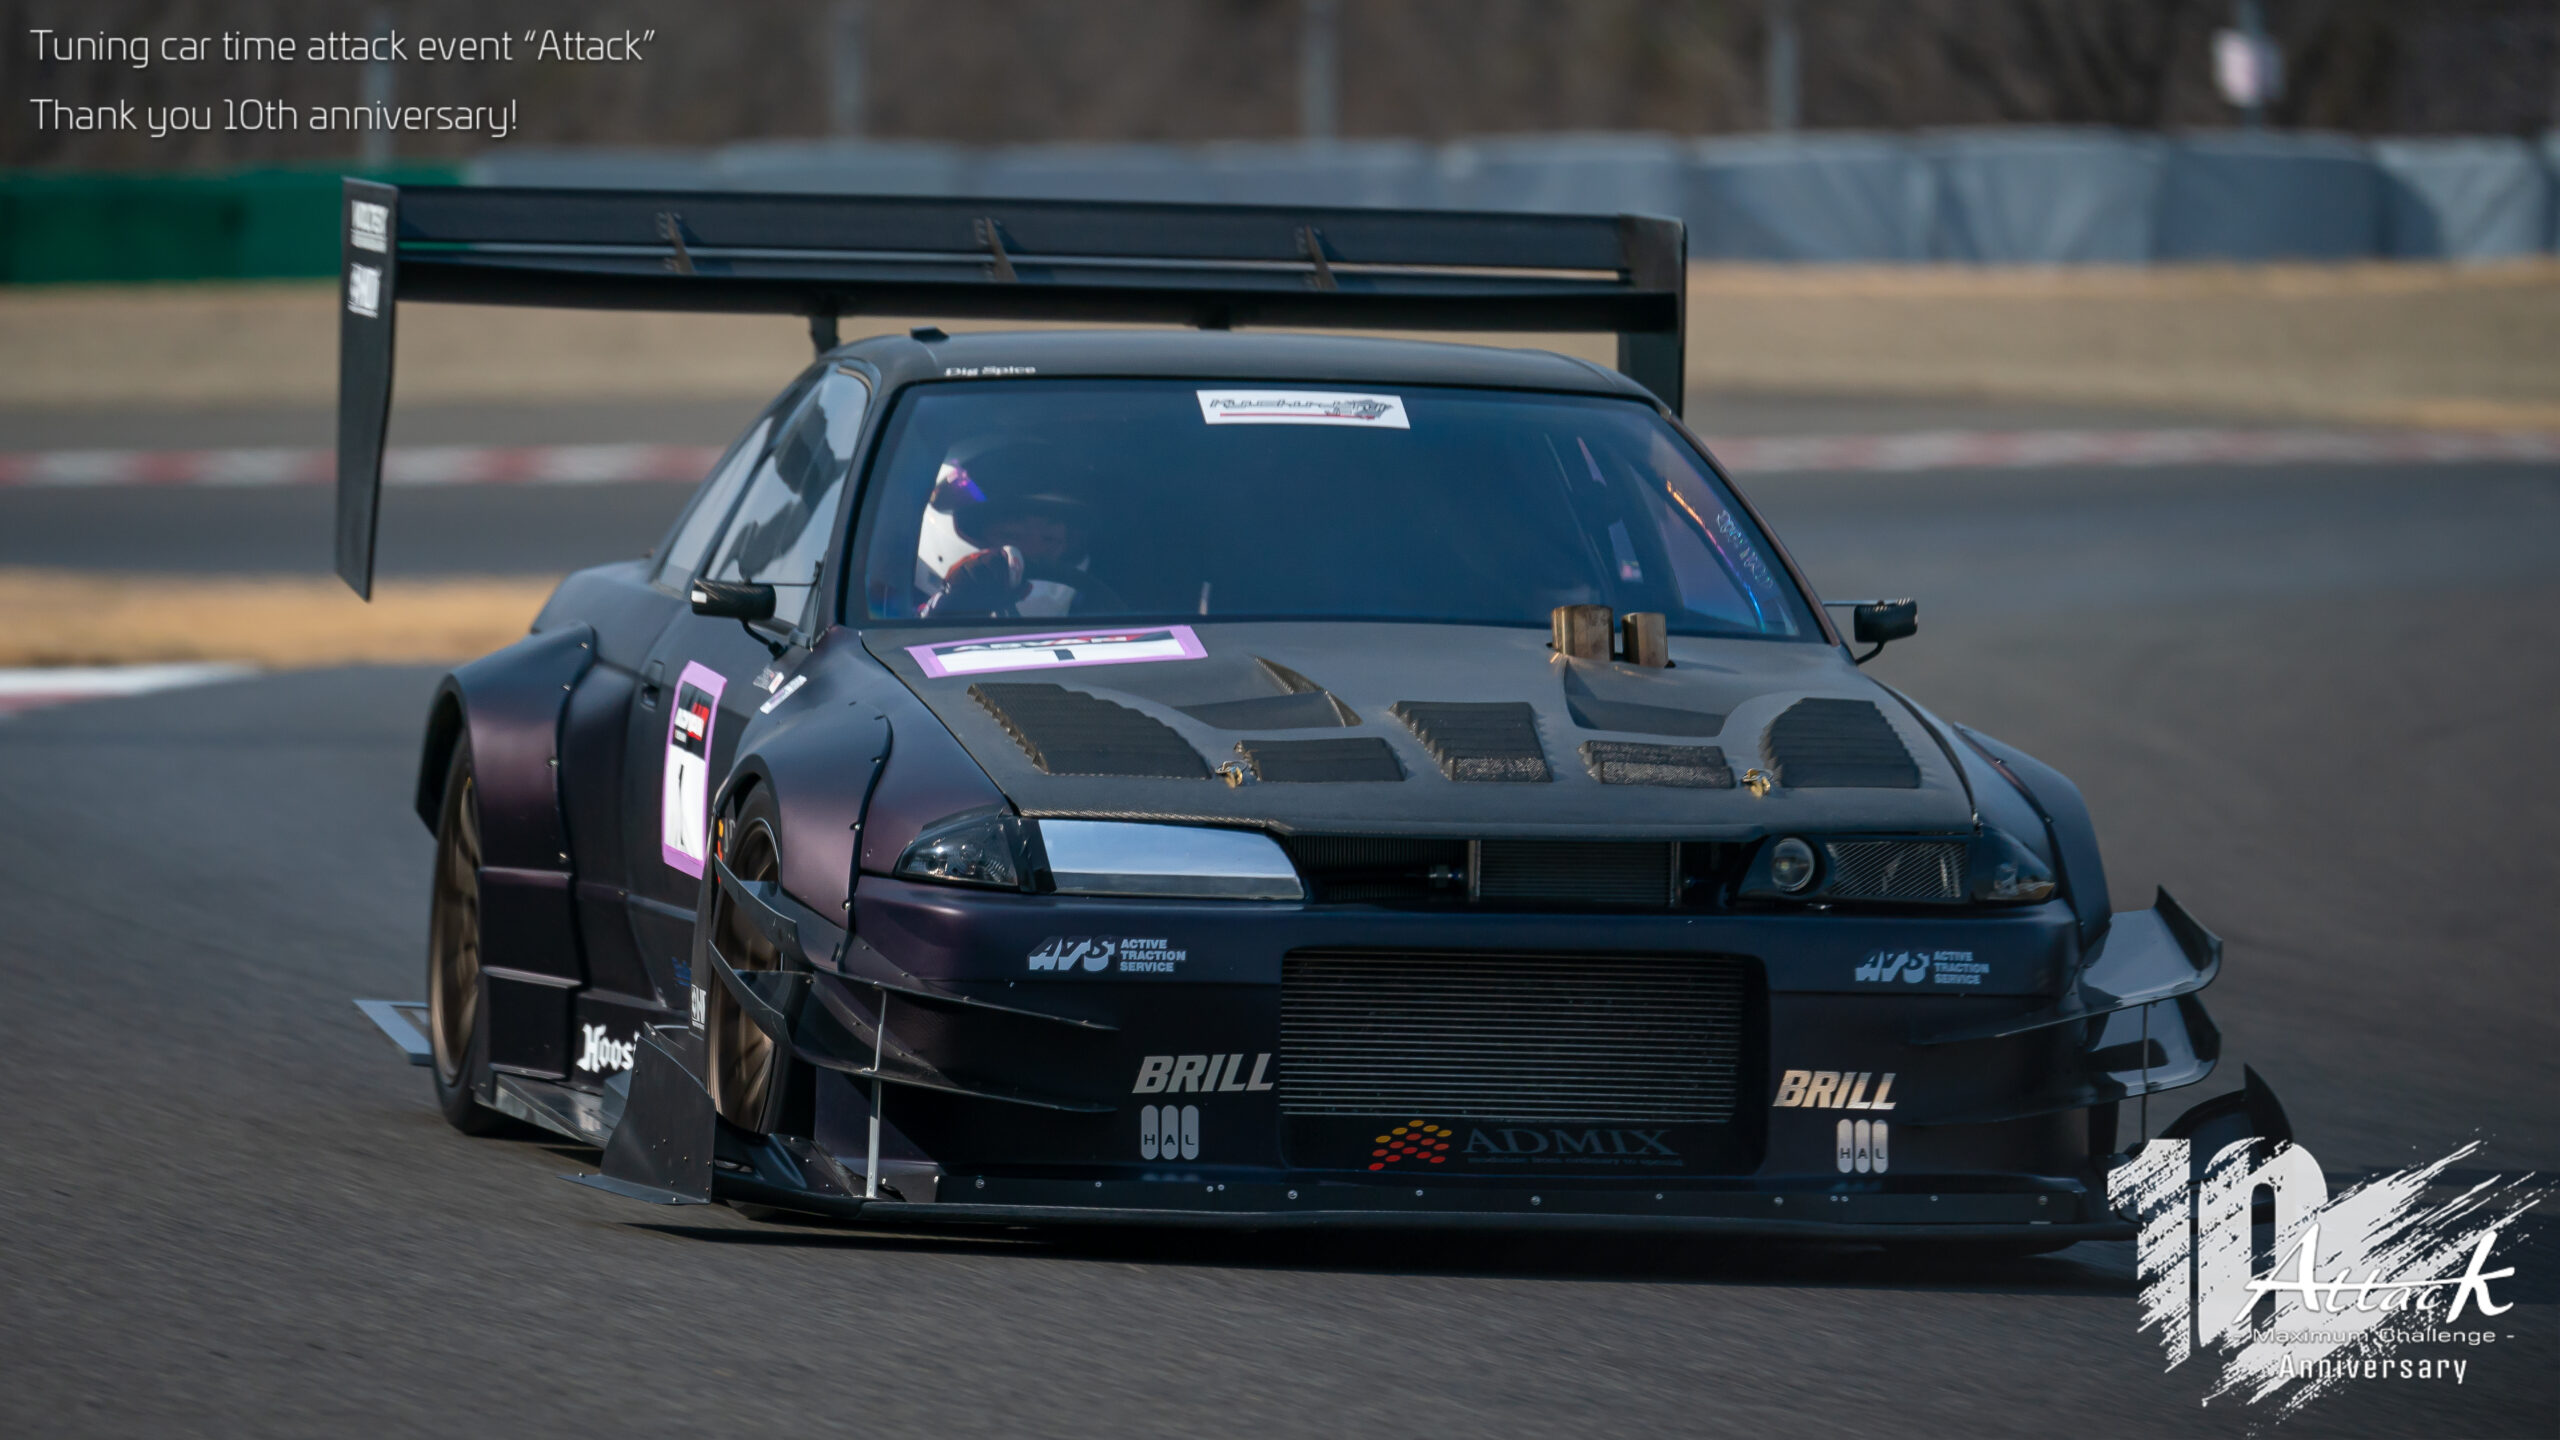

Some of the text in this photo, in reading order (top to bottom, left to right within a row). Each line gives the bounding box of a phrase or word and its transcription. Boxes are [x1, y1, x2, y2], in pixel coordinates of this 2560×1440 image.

[1120, 938, 1168, 949] ACTIVE
[1120, 950, 1187, 961] TRACTION
[1933, 951, 1974, 962] ACTIVE
[1120, 962, 1175, 972] SERVICE
[1933, 962, 1990, 974] TRACTION
[1934, 973, 1981, 985] SERVICE
[1131, 1053, 1274, 1094] BRILL
[1772, 1069, 1897, 1111] BRILL
[1143, 1133, 1196, 1146] HAL
[1461, 1128, 1680, 1155] ADMIX
[1839, 1147, 1886, 1160] HAL
